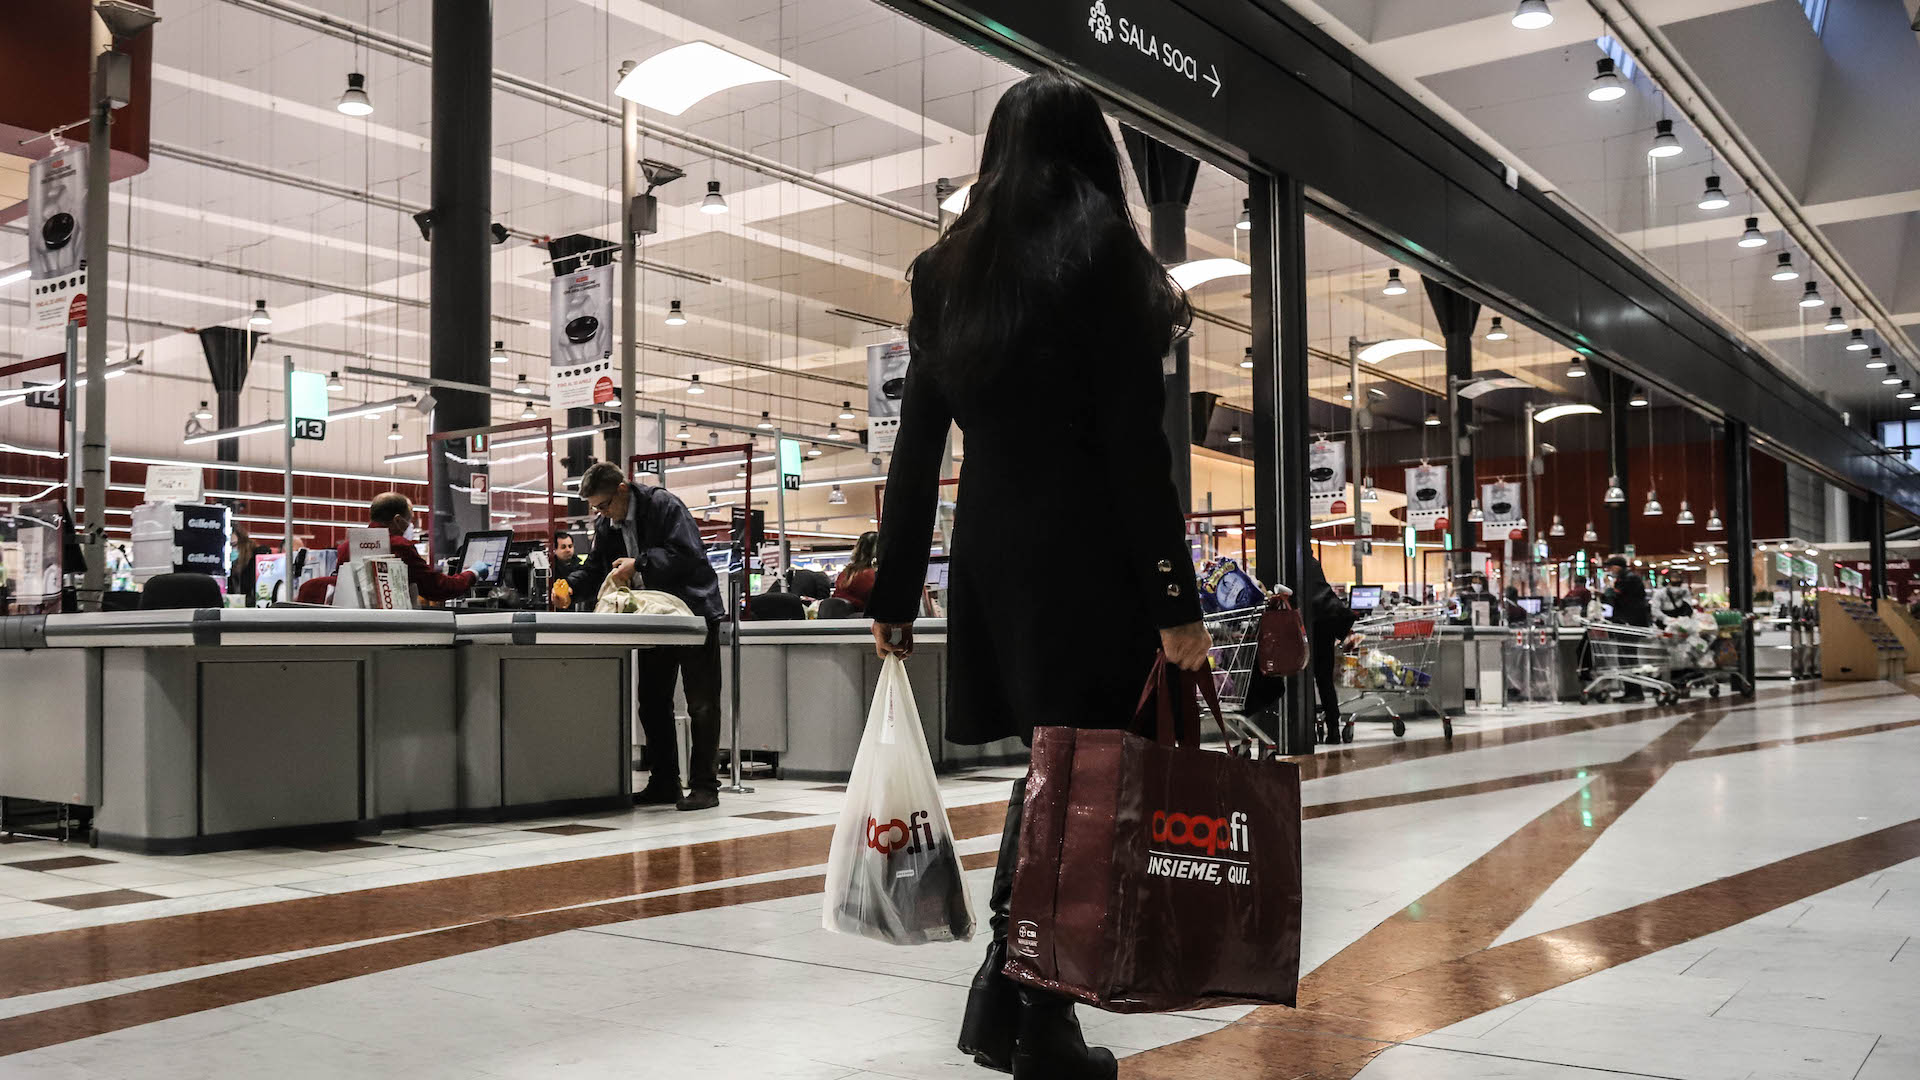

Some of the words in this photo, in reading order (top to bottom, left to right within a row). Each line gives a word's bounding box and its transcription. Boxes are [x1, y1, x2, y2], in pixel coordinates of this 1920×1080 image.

[1119, 17, 1160, 61] SALA
[1162, 42, 1197, 82] SOCI
[296, 418, 324, 438] 13
[639, 460, 658, 472] 12
[785, 475, 799, 489] 11
[188, 518, 221, 530] Gillette
[359, 540, 381, 550] coop.fi
[187, 553, 221, 564] Gillette
[1147, 856, 1222, 885] INSIEME,
[1228, 865, 1250, 885] QUI.
[1026, 930, 1037, 938] CSI
